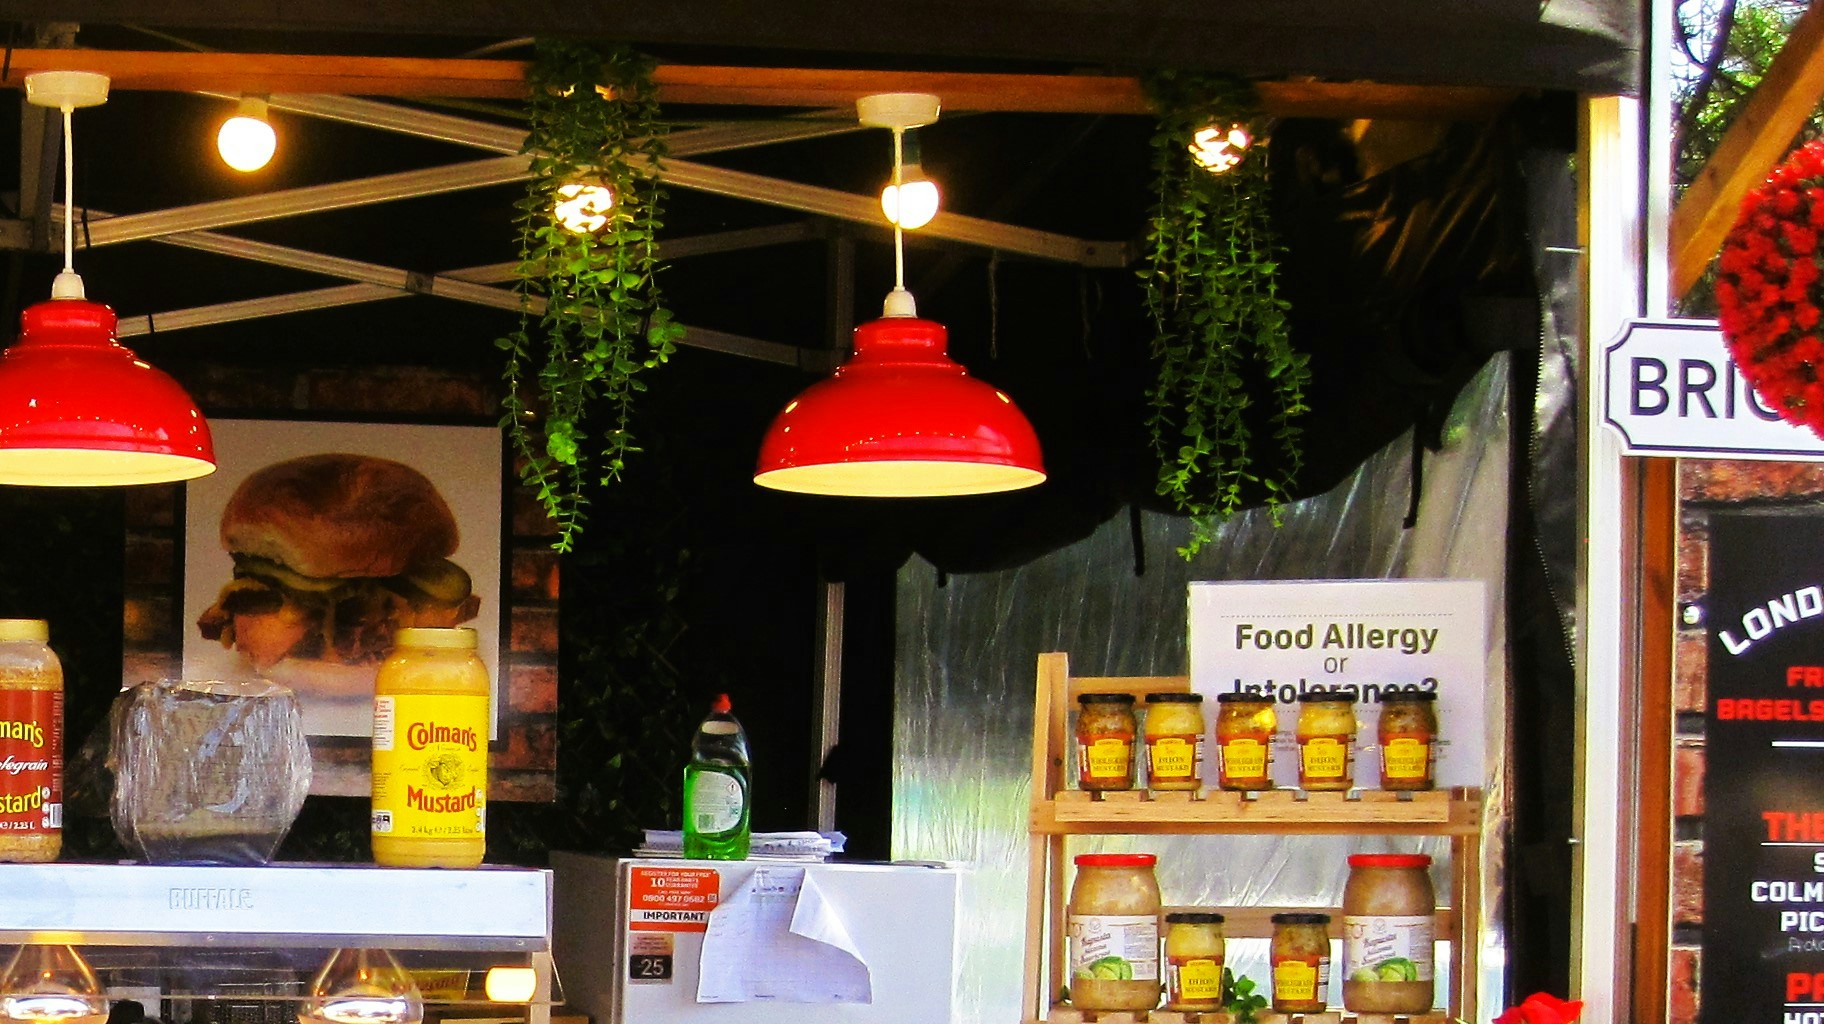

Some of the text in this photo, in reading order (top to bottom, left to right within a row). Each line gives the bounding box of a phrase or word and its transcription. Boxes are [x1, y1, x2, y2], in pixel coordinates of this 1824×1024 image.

[1235, 622, 1439, 655] Food Allergy
[1324, 656, 1349, 674] or
[1717, 698, 1824, 721] BAGELS
[407, 722, 477, 752] Colman's
[407, 785, 476, 813] Mustard
[650, 877, 665, 888] 10
[643, 911, 705, 921] IMPORTANT
[640, 957, 665, 976] 25
